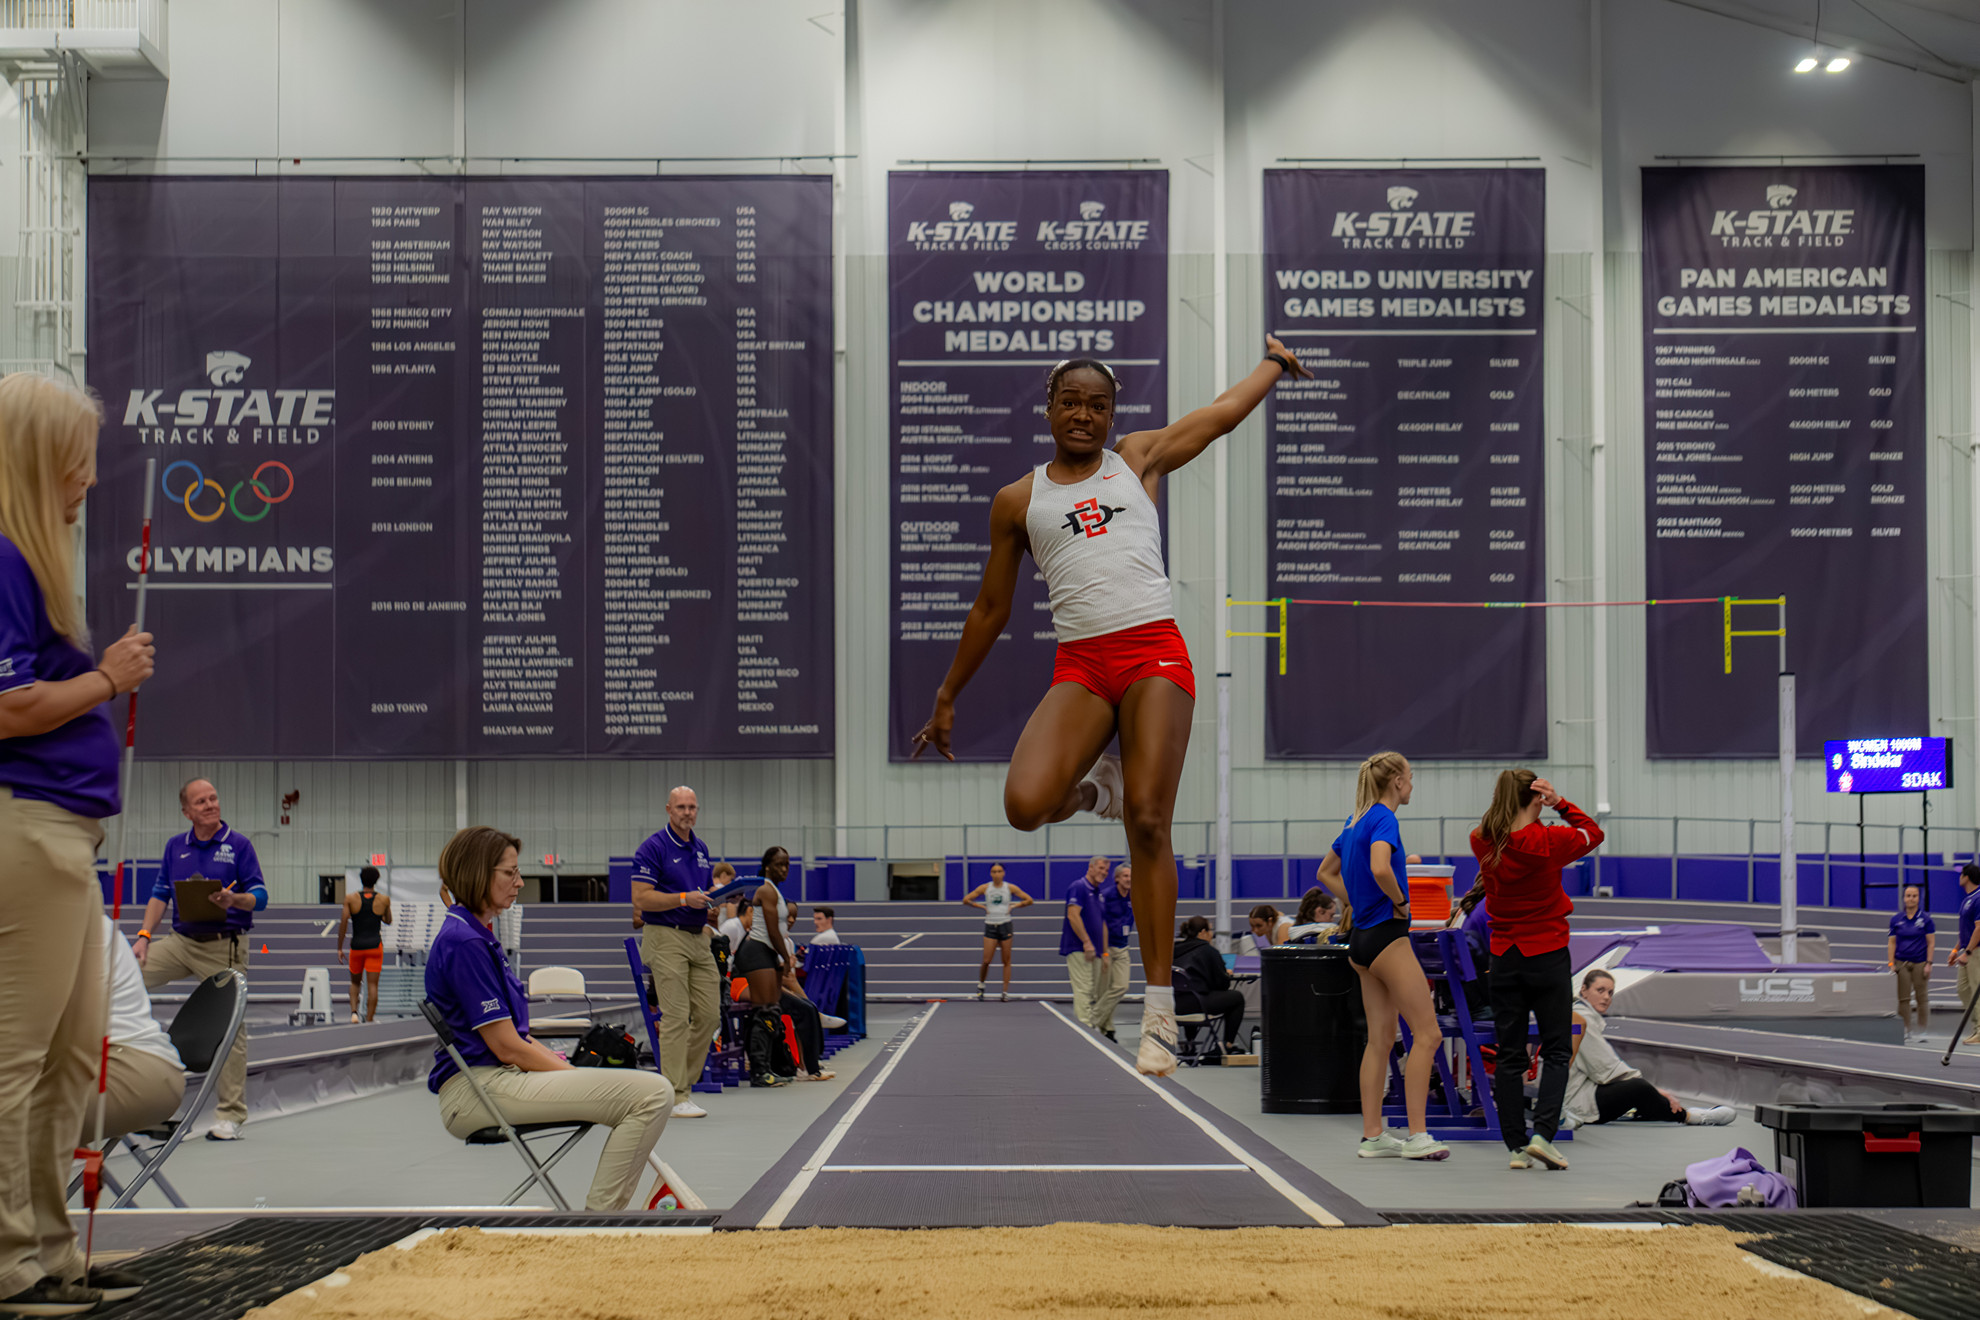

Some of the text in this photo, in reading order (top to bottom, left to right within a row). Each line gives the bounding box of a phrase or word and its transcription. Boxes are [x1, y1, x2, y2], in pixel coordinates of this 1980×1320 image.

[394, 207, 440, 215] ANTWERP
[483, 207, 541, 215] RAY WATSON
[737, 207, 755, 215] USA
[631, 218, 674, 226] HURDLES
[675, 218, 720, 226] (BRONZE)
[1332, 212, 1475, 237] K-STATE
[1711, 210, 1855, 235] K-STATE
[627, 230, 663, 238] METERS
[907, 222, 1017, 241] K-STATE
[1036, 221, 1149, 241] K-STATE
[393, 241, 450, 249] AMSTERDAM
[1044, 241, 1140, 250] CROSS COUNTRY
[1342, 238, 1464, 249] TRACK & FIELD
[1722, 236, 1844, 247] TRACK & FIELD
[915, 242, 1010, 251] TRACK & FIELD
[393, 252, 432, 260] LONDON
[483, 252, 511, 260] WARD
[483, 263, 546, 271] THANE BAKER
[393, 275, 449, 283] MELBOURNE
[1276, 270, 1533, 289] WORLD UNIVERSITY
[1681, 267, 1887, 288] PAN AMERICAN
[973, 272, 1085, 293] WORLD
[1284, 298, 1526, 317] GAMES MEDALISTS
[1658, 295, 1910, 316] GAMES MEDALISTS
[393, 308, 429, 317] MEXICO
[430, 308, 451, 317] CITY
[483, 308, 584, 316] CONRAD NIGHTINGALE
[913, 301, 1145, 322] CHAMPIONSHIP
[392, 320, 429, 328] MUNICH
[521, 320, 549, 328] HOWE
[945, 330, 1114, 352] MEDALISTS
[393, 342, 412, 350] LOS
[413, 342, 455, 350] ANGELES
[604, 342, 663, 350] HEPTATHLON
[737, 342, 805, 350] GREAT BRITAIN
[604, 353, 658, 361] POLE VAULT
[393, 365, 435, 373] ATLANTA
[604, 365, 653, 373] HIGH JUMP
[483, 376, 539, 384] STEVE FRITZ
[604, 376, 659, 384] DECATHLON
[483, 387, 563, 395] KENNY HARRISON
[605, 387, 696, 395] TRIPLE JUMP (GOLD)
[900, 382, 946, 392] INDOOR
[122, 389, 335, 426] K-STATE
[737, 409, 788, 417] AUSTRALIA
[372, 421, 433, 430] 2000 SYDNEY
[483, 421, 521, 429] NATHAN
[139, 428, 320, 445] TRACK & FIELD
[737, 443, 782, 452] HUNGARY
[372, 455, 433, 463] 2004 ATHENS
[396, 478, 432, 486] BEIJING
[738, 477, 778, 486] JAMAICA
[483, 500, 561, 508] CHRISTIAN SMITH
[393, 523, 432, 531] LONDON
[900, 522, 960, 532] OUTDOOR
[127, 547, 333, 572] OLYMPIANS
[738, 578, 799, 587] PUERTO RICO
[394, 602, 411, 610] RIO
[412, 602, 425, 610] DE
[426, 602, 466, 610] JANEIRO
[483, 613, 545, 621] AKELA JONES
[738, 612, 788, 620] BARBADOS
[605, 658, 638, 666] DISCUS
[738, 680, 778, 688] CANADA
[483, 692, 552, 700] CLIFF ROVELTO
[396, 704, 427, 712] TOKYO
[483, 704, 553, 712] LAURA GALVAN
[738, 703, 774, 711] MEXICO
[625, 726, 662, 734] METERS
[1902, 772, 1942, 787] SDAK
[1739, 978, 1815, 995] UCS
